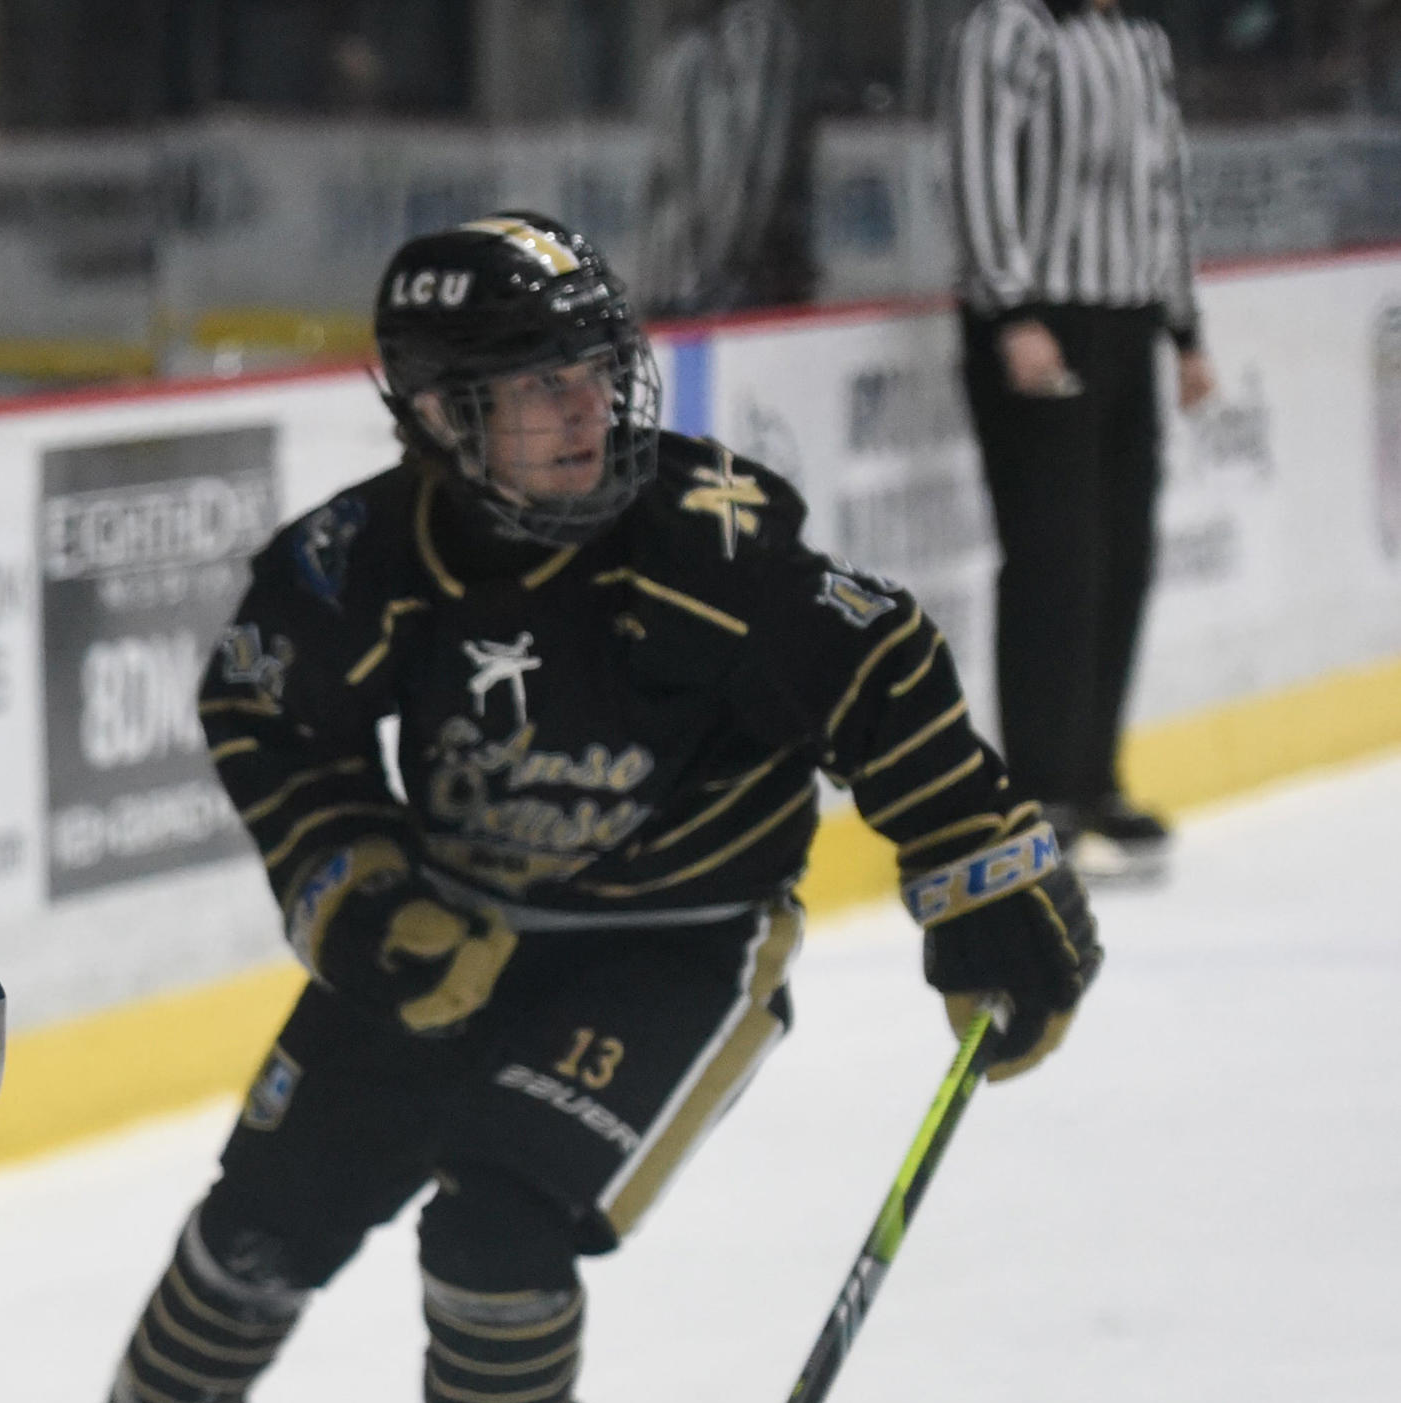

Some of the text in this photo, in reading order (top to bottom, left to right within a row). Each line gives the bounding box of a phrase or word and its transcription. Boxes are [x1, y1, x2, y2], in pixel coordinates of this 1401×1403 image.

[389, 268, 474, 308] LCU
[907, 832, 1058, 920] CCM
[554, 1027, 624, 1090] 13
